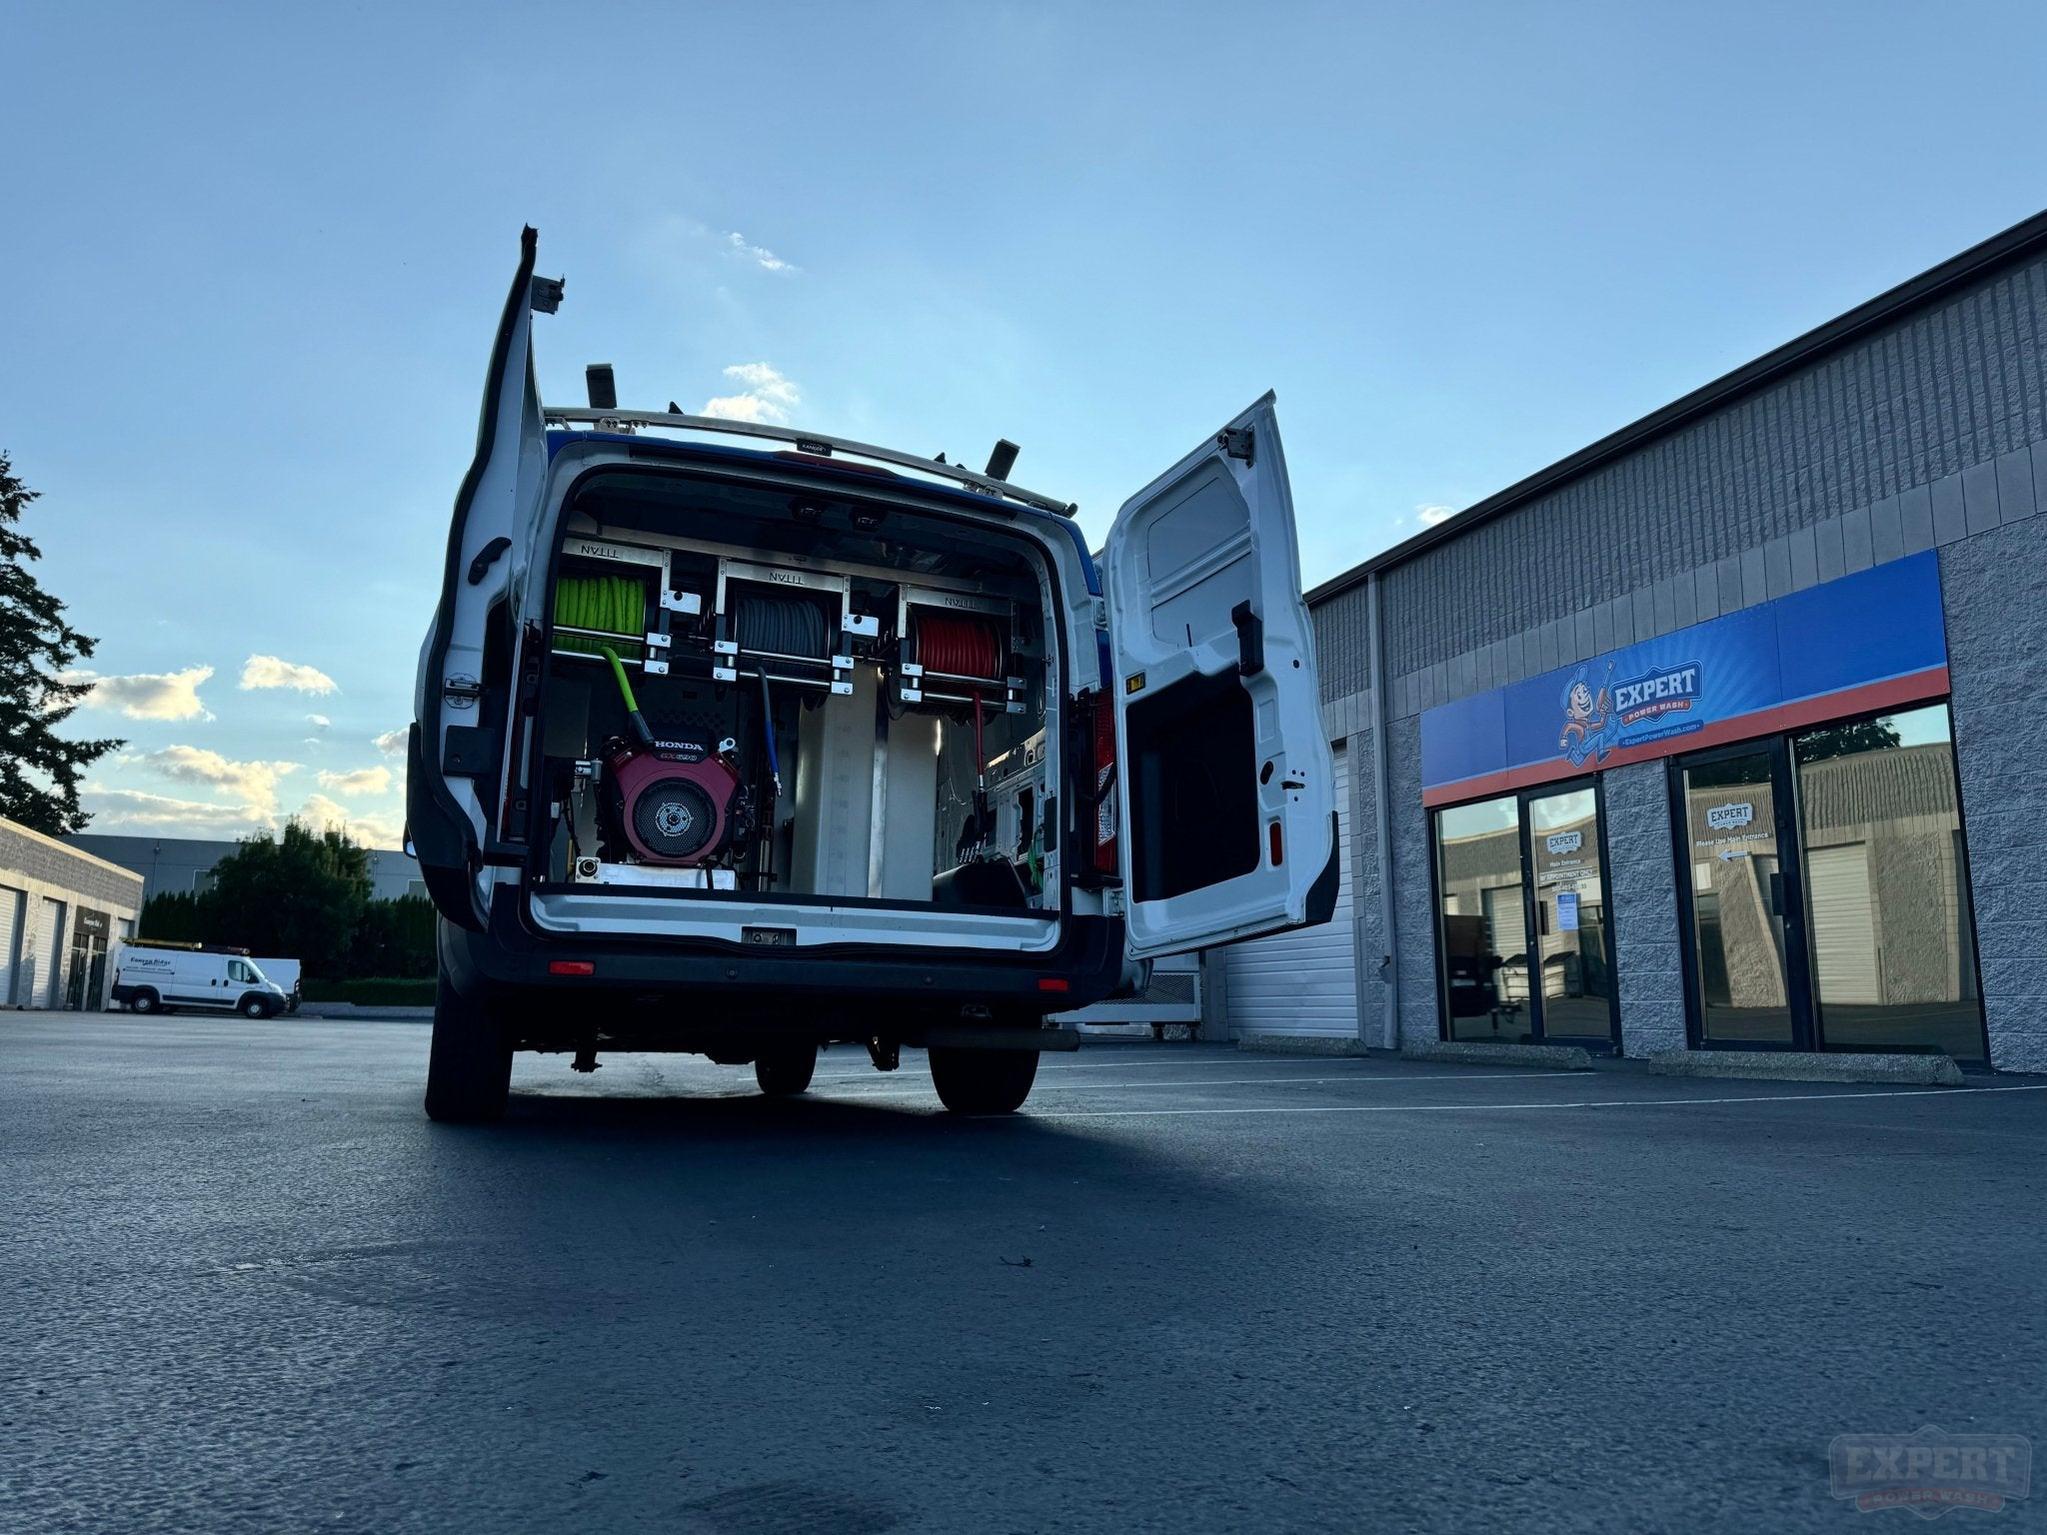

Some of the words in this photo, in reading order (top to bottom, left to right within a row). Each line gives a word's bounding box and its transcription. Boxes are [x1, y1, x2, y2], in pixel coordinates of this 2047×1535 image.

[581, 545, 619, 559] TITAN
[768, 572, 804, 585] TITAN
[1615, 668, 1695, 711] EXPERT
[1628, 704, 1657, 720] POWER
[1660, 701, 1684, 711] WASH
[655, 741, 704, 752] HONDA
[1711, 806, 1749, 822] EXPERT
[1549, 834, 1578, 848] EXPERT
[1743, 832, 1769, 841] Entrance
